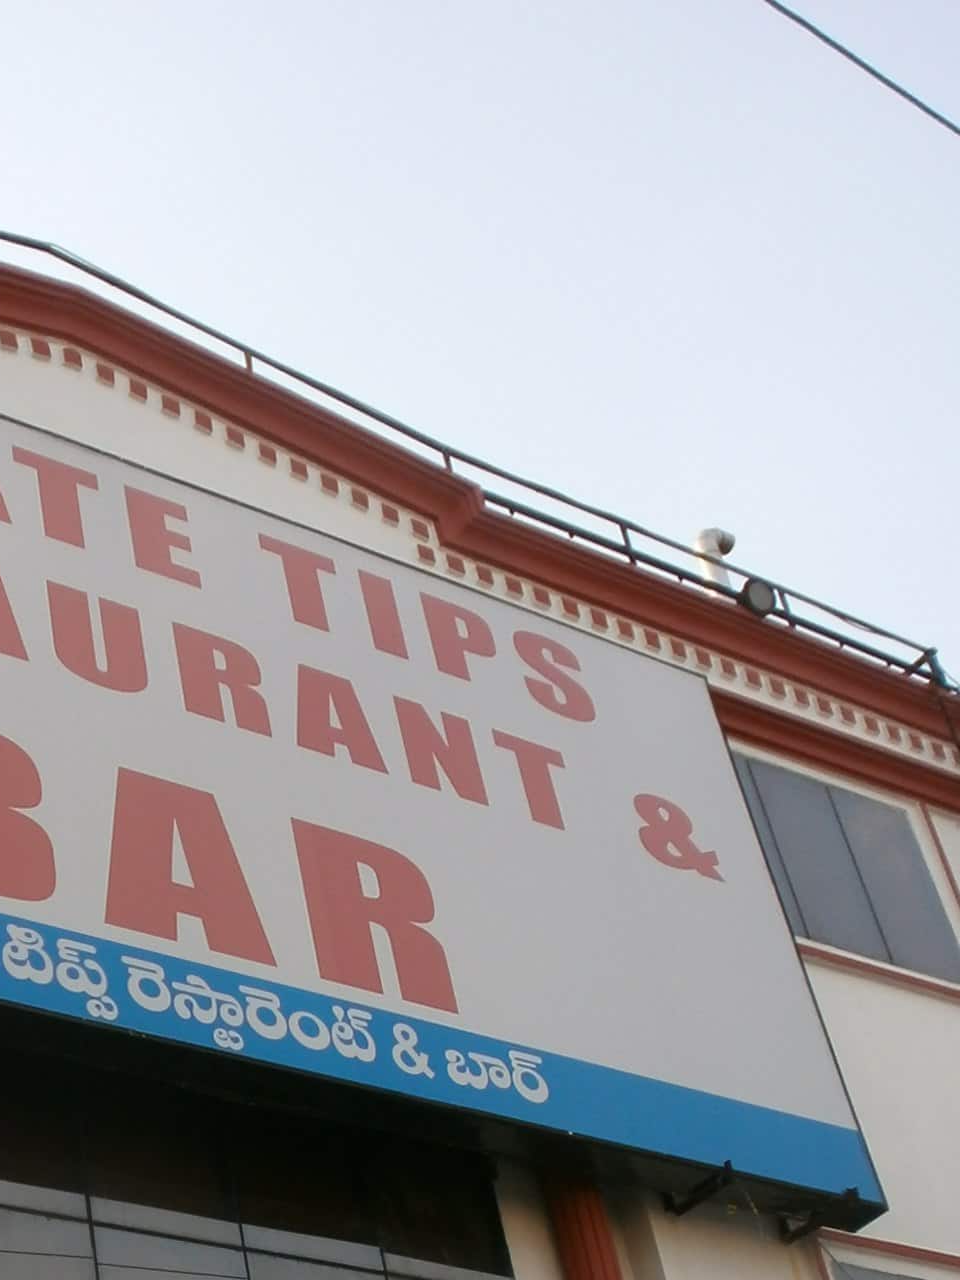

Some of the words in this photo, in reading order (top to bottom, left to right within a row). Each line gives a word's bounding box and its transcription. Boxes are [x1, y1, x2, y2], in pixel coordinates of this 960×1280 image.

[258, 533, 596, 723] TIPS
[633, 793, 725, 882] &
[121, 955, 376, 1062] రెస్టారెంట్
[392, 1023, 435, 1079] &
[445, 1050, 549, 1103] బార్
